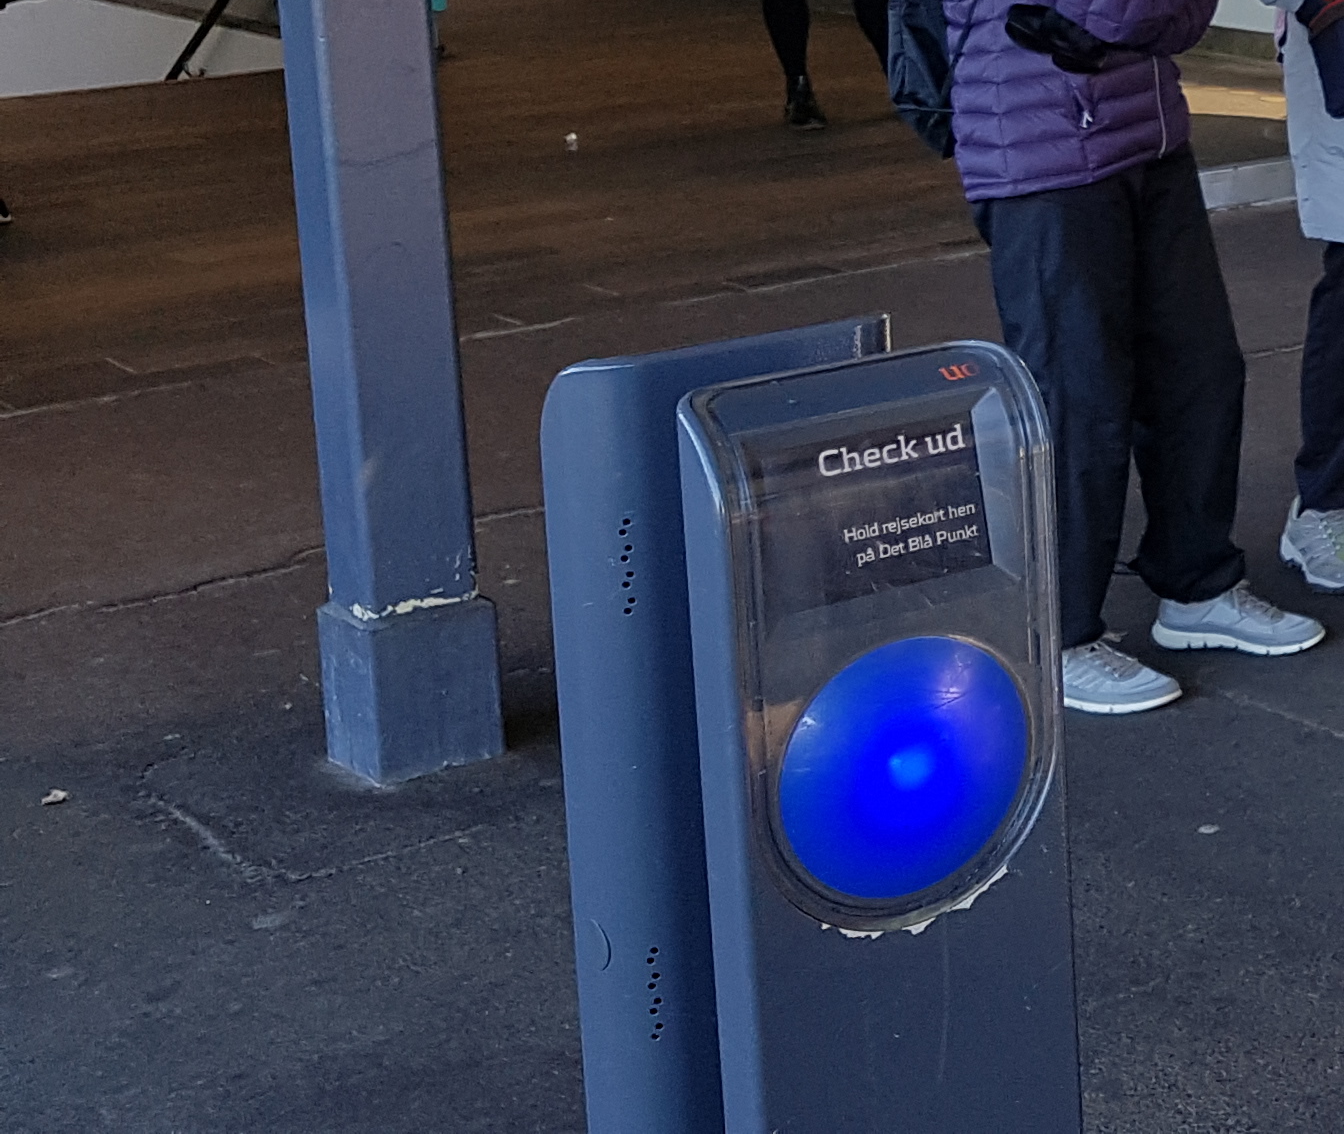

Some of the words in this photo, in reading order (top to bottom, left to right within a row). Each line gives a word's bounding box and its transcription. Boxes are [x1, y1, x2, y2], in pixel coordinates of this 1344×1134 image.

[818, 435, 918, 477] Check
[925, 423, 966, 455] ud
[843, 521, 879, 544] Hold
[881, 509, 945, 535] rejsekort
[948, 504, 976, 519] hen
[856, 547, 875, 567] på
[879, 542, 906, 558] Det
[908, 534, 933, 552] Blå
[936, 525, 979, 545] Punkt
